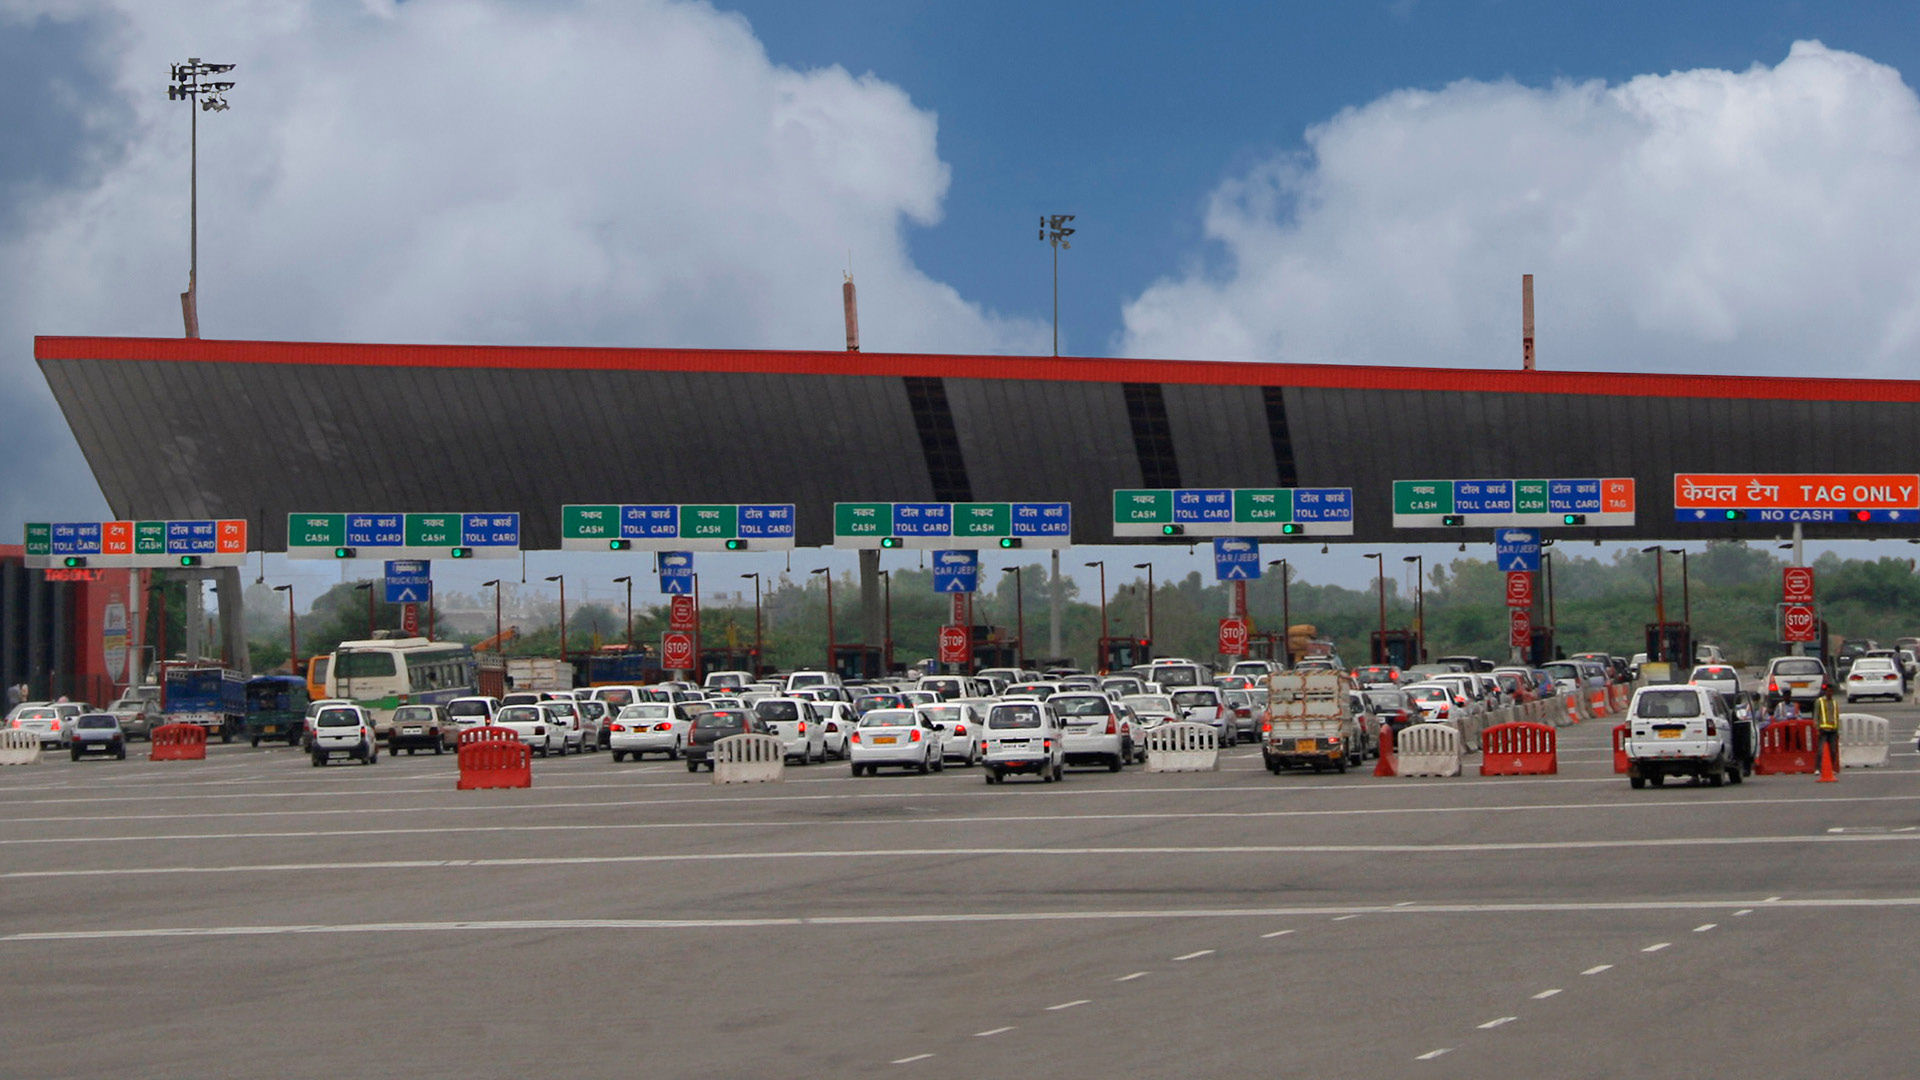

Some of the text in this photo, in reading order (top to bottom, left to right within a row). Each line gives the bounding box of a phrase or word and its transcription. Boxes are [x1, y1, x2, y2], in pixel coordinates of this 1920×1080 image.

[1681, 478, 1779, 501] केवल टैग
[1800, 485, 1913, 502] TAG ONLY
[1410, 501, 1437, 510] CASH
[1456, 500, 1511, 510] TOLL CARD
[1519, 500, 1544, 509] CASH
[1550, 500, 1599, 509] TOLL CARD
[1609, 499, 1626, 508] TAG
[1131, 510, 1156, 519] CASH
[1176, 510, 1230, 519] TOLL CARD
[1251, 510, 1276, 518] CASH
[1296, 509, 1318, 518] TOLL
[1761, 510, 1834, 520] NO CASH
[578, 525, 604, 534] CASH
[623, 525, 675, 534] TOLL CARD
[695, 525, 721, 533] CASH
[741, 524, 792, 533] TOLL CARD
[851, 523, 876, 532] CASH
[896, 523, 949, 532] TOLL CARD
[969, 523, 994, 532] CASH
[1014, 523, 1067, 532] TOLL CARD
[305, 533, 330, 542] CASH
[350, 533, 401, 542] TOLL CARD
[421, 533, 446, 542] CASH
[465, 533, 516, 542] TOLL CARD
[28, 542, 49, 551] CASH
[53, 542, 74, 551] TOLL
[109, 542, 126, 550] TAG
[138, 541, 162, 550] CASH
[168, 540, 215, 550] TOLL CARD
[223, 540, 239, 549] TAG
[1788, 614, 1810, 625] STOP
[1223, 627, 1244, 638] STOP
[943, 636, 963, 647] STOP
[667, 642, 688, 654] STOP
